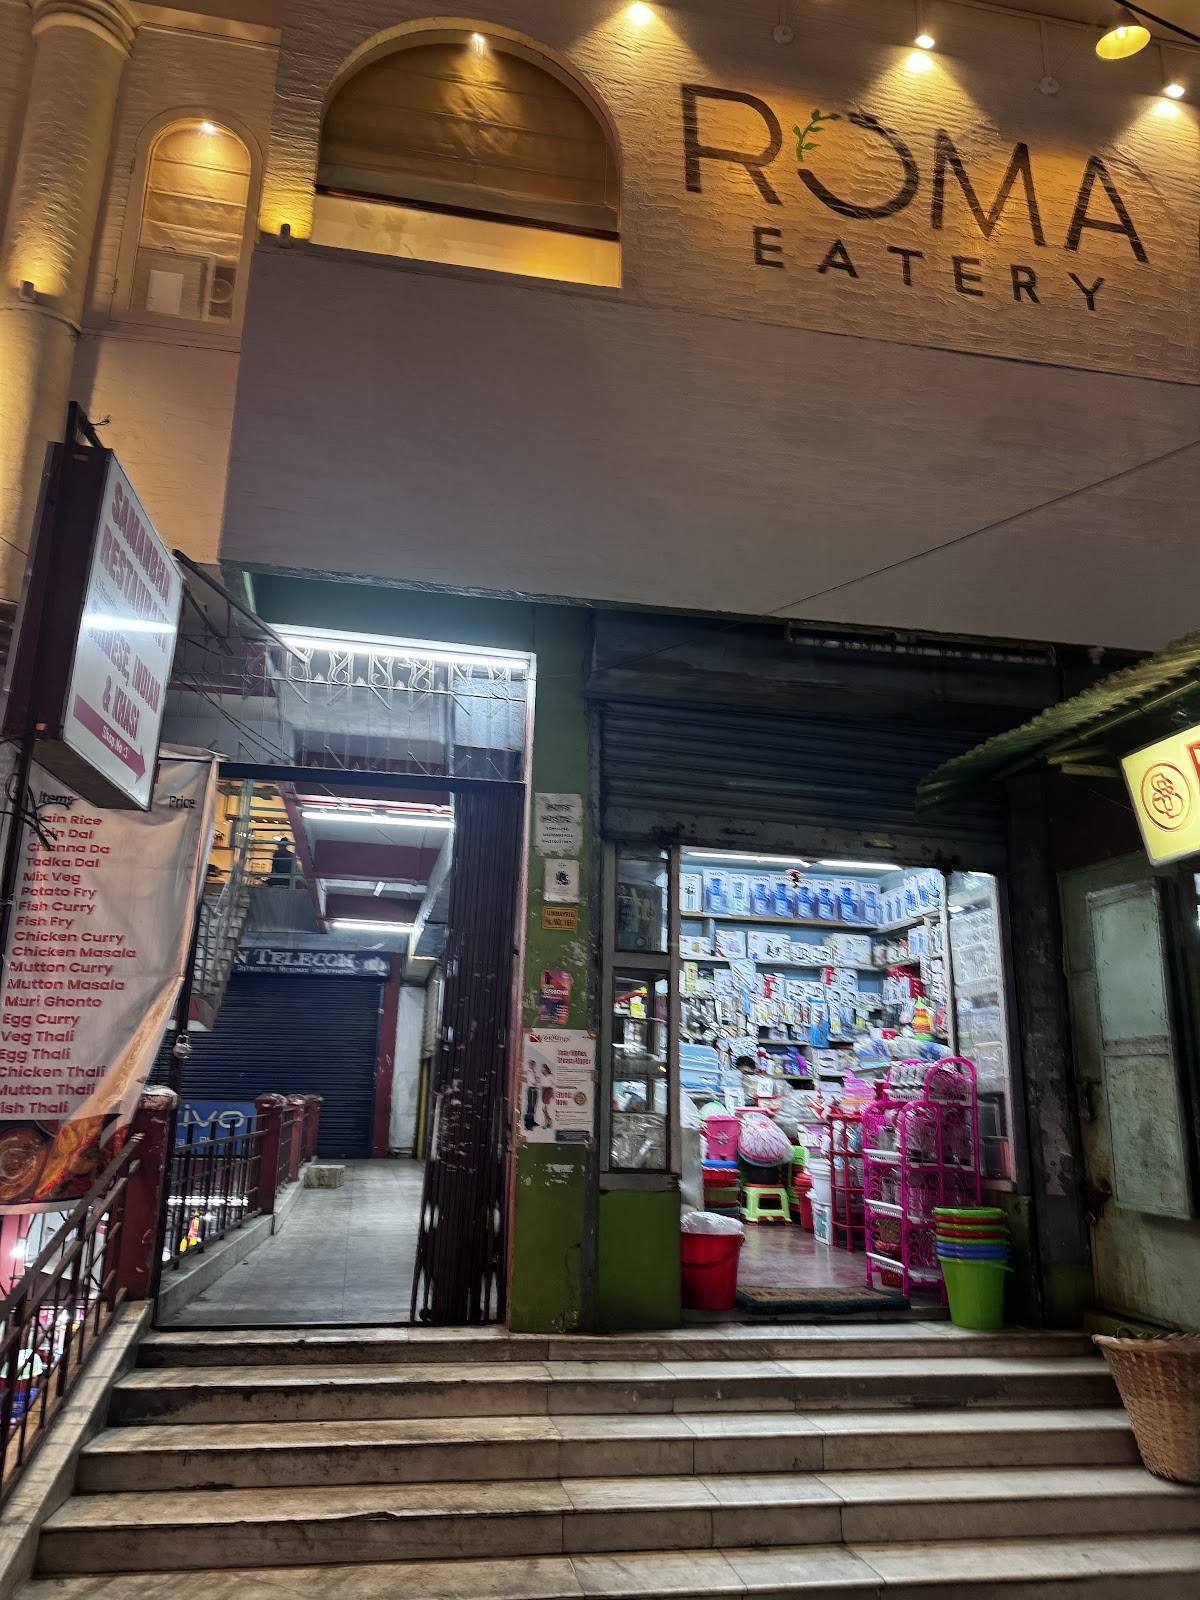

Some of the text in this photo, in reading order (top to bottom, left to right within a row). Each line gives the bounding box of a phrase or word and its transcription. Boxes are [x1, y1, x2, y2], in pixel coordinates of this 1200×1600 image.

[681, 83, 1149, 264] ROMA
[753, 225, 1104, 311] EATERY
[132, 655, 161, 713] INDIAN
[102, 675, 140, 741] & KHASI
[39, 790, 196, 809] Items Price
[70, 815, 103, 825] Rice
[68, 829, 95, 840] Dal
[26, 856, 101, 868] Tadka Dal
[22, 871, 82, 885] Mix Veg
[20, 886, 97, 900] Potato Fry
[18, 901, 96, 914] Fish Curry
[16, 916, 75, 929] Fish Fry
[13, 931, 126, 945] Chicken Curry
[11, 946, 137, 958] Chicken Masala
[8, 961, 114, 976] Mutton Curry
[6, 978, 126, 991] Mutton Masala
[4, 995, 103, 1007] Muri Ghonto
[2, 1013, 81, 1028] Egg Curry
[0, 1030, 75, 1045] Veg Thali
[0, 1048, 71, 1063] Egg Thali
[0, 1065, 106, 1077] Chicken Thali
[59, 1082, 97, 1095] Thali
[0, 1101, 69, 1114] ish Thali
[178, 1103, 244, 1128] ivo
